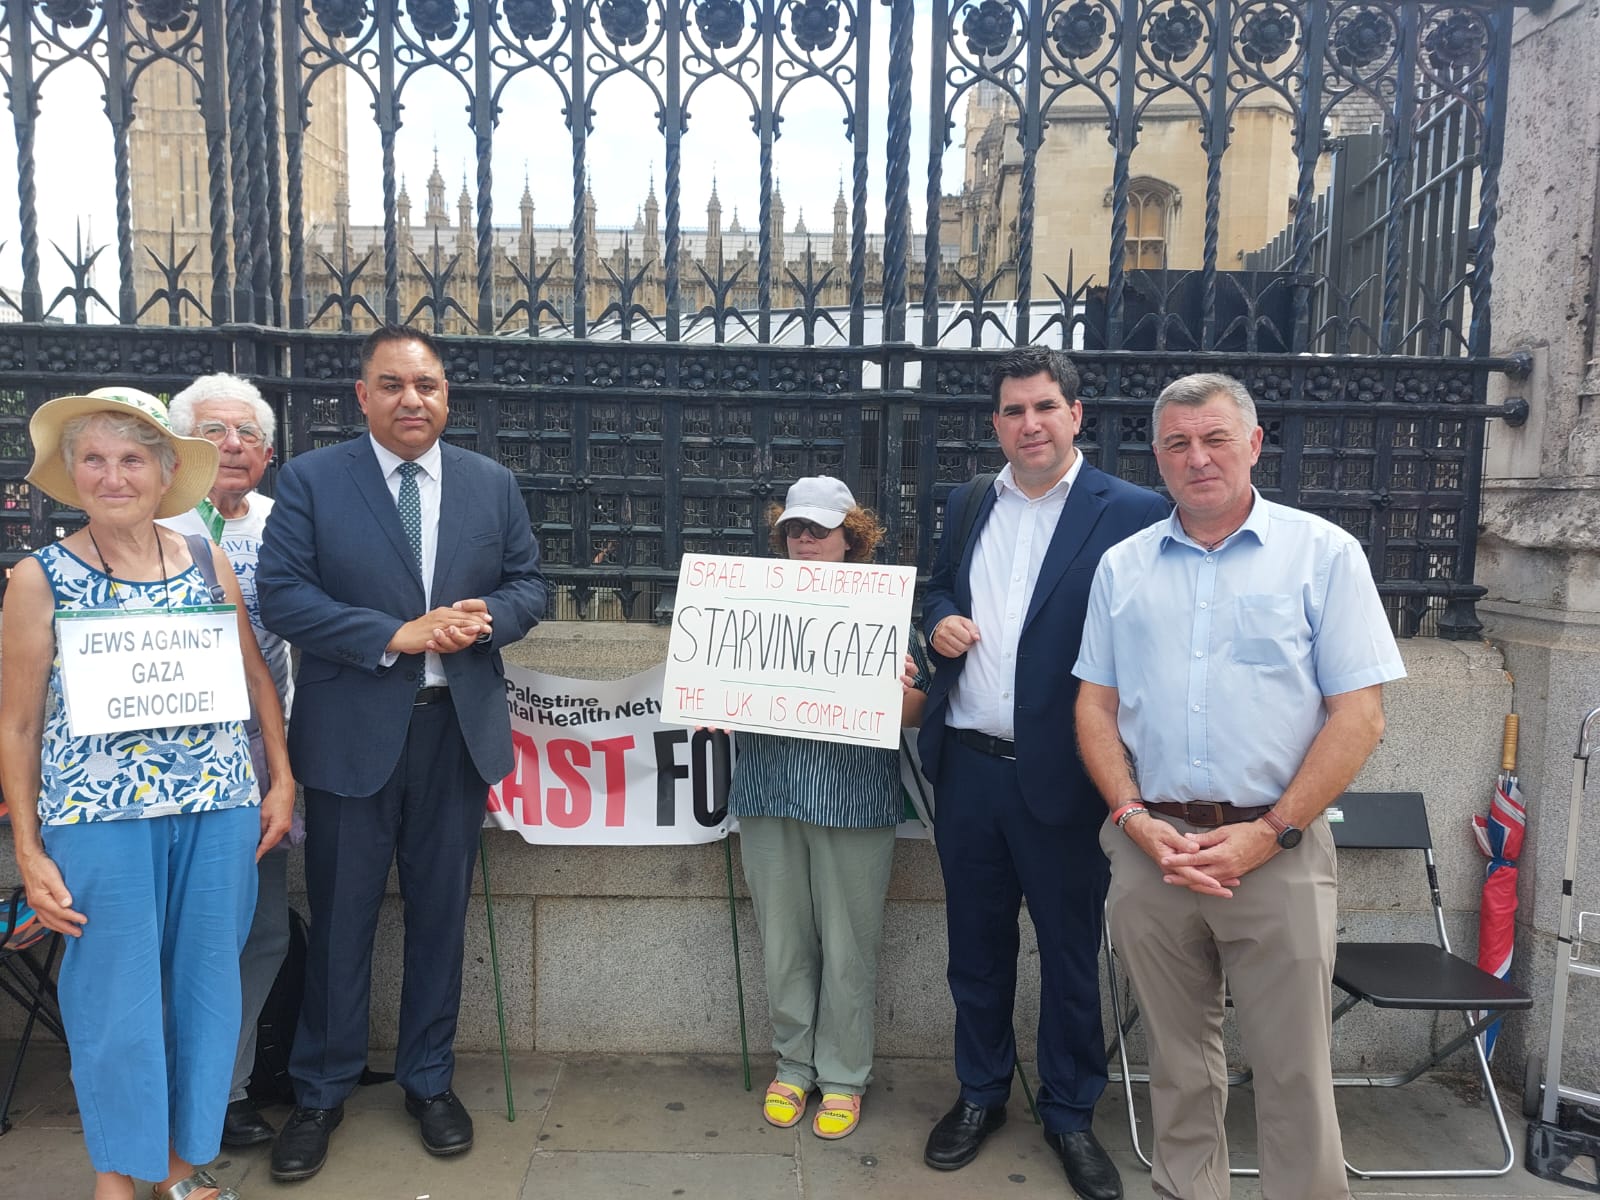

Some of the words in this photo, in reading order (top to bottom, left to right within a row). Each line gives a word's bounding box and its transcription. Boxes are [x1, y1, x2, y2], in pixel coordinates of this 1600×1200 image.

[686, 561, 746, 588] ISRAEL
[766, 565, 784, 589] IS
[796, 566, 910, 597] DELIBERATELY
[79, 630, 135, 655] JEWS
[141, 627, 224, 651] AGAINST
[673, 605, 819, 675] STARVING
[824, 621, 898, 680] GAZA
[132, 661, 185, 684] GAZA
[107, 690, 215, 719] GENOCIDE!
[504, 678, 599, 709] Palestine
[538, 707, 610, 727] Health
[675, 687, 704, 710] THE
[725, 693, 753, 717] UK
[769, 696, 787, 722] IS
[796, 701, 885, 734] COMPLICIT
[488, 729, 635, 829] AST
